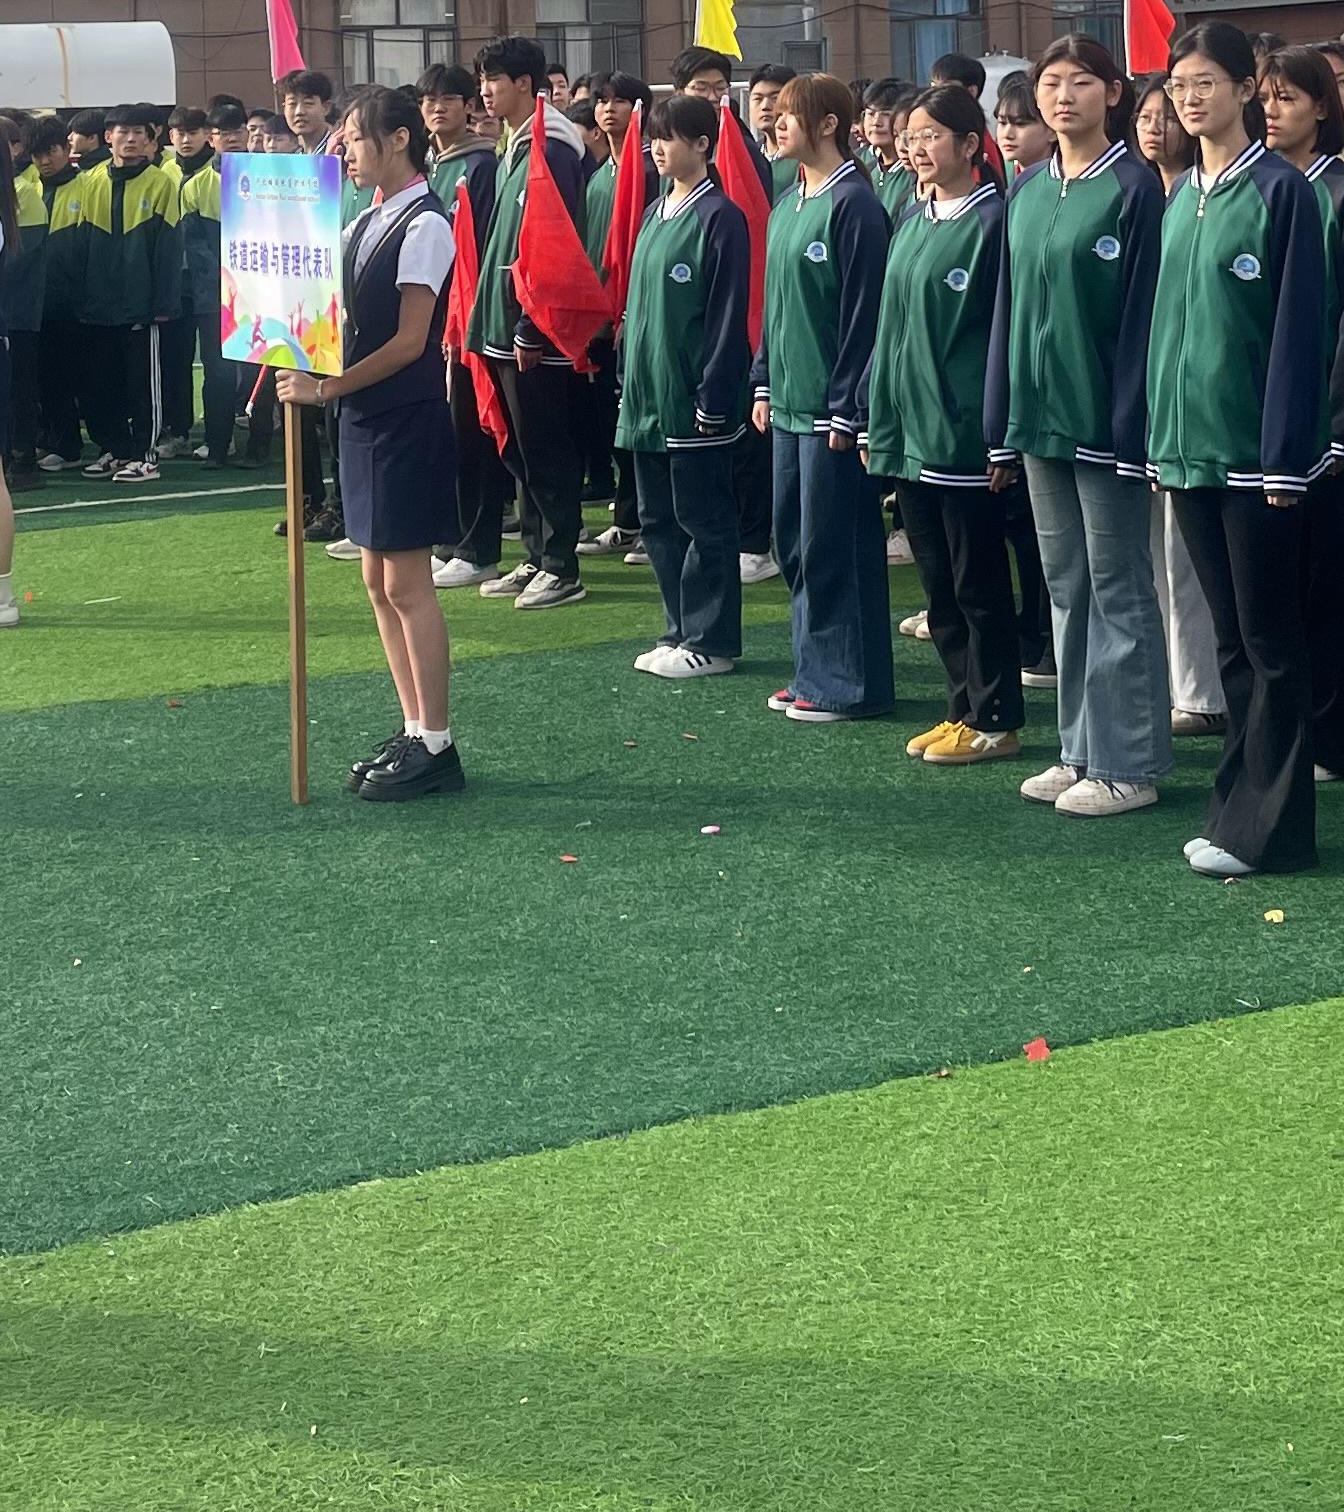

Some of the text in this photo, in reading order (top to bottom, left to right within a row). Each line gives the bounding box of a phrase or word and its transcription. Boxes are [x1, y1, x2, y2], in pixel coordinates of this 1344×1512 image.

[230, 240, 333, 279] 铁道运输与管理代表队
